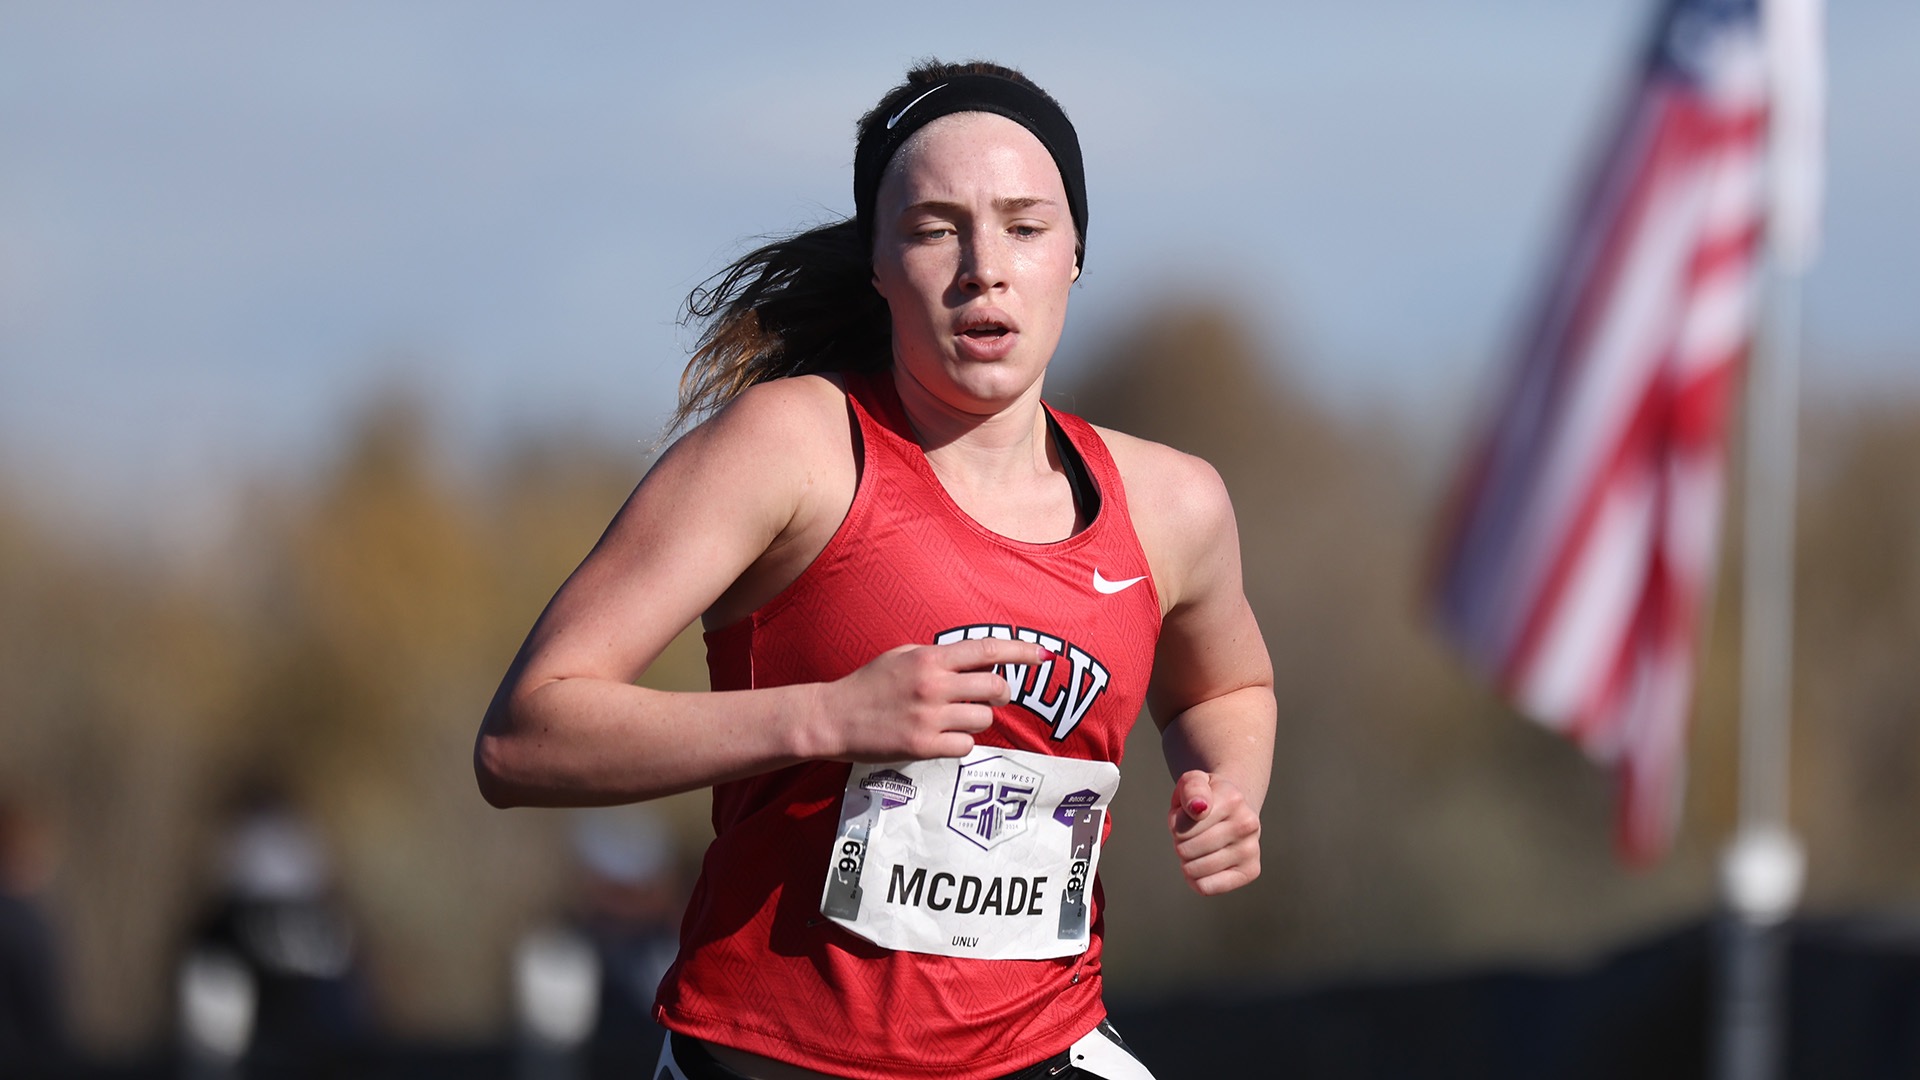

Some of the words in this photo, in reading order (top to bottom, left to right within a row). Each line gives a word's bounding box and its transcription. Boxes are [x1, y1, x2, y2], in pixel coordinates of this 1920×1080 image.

[934, 623, 1111, 742] NLV
[967, 770, 1006, 779] MOUNTAIN
[1011, 773, 1036, 784] WEST
[863, 780, 884, 789] CROSS
[885, 781, 914, 796] COUNTRY
[956, 780, 1034, 821] 25
[1064, 808, 1077, 818] 202
[887, 864, 1048, 916] MCDADE
[951, 935, 980, 948] UNLV
